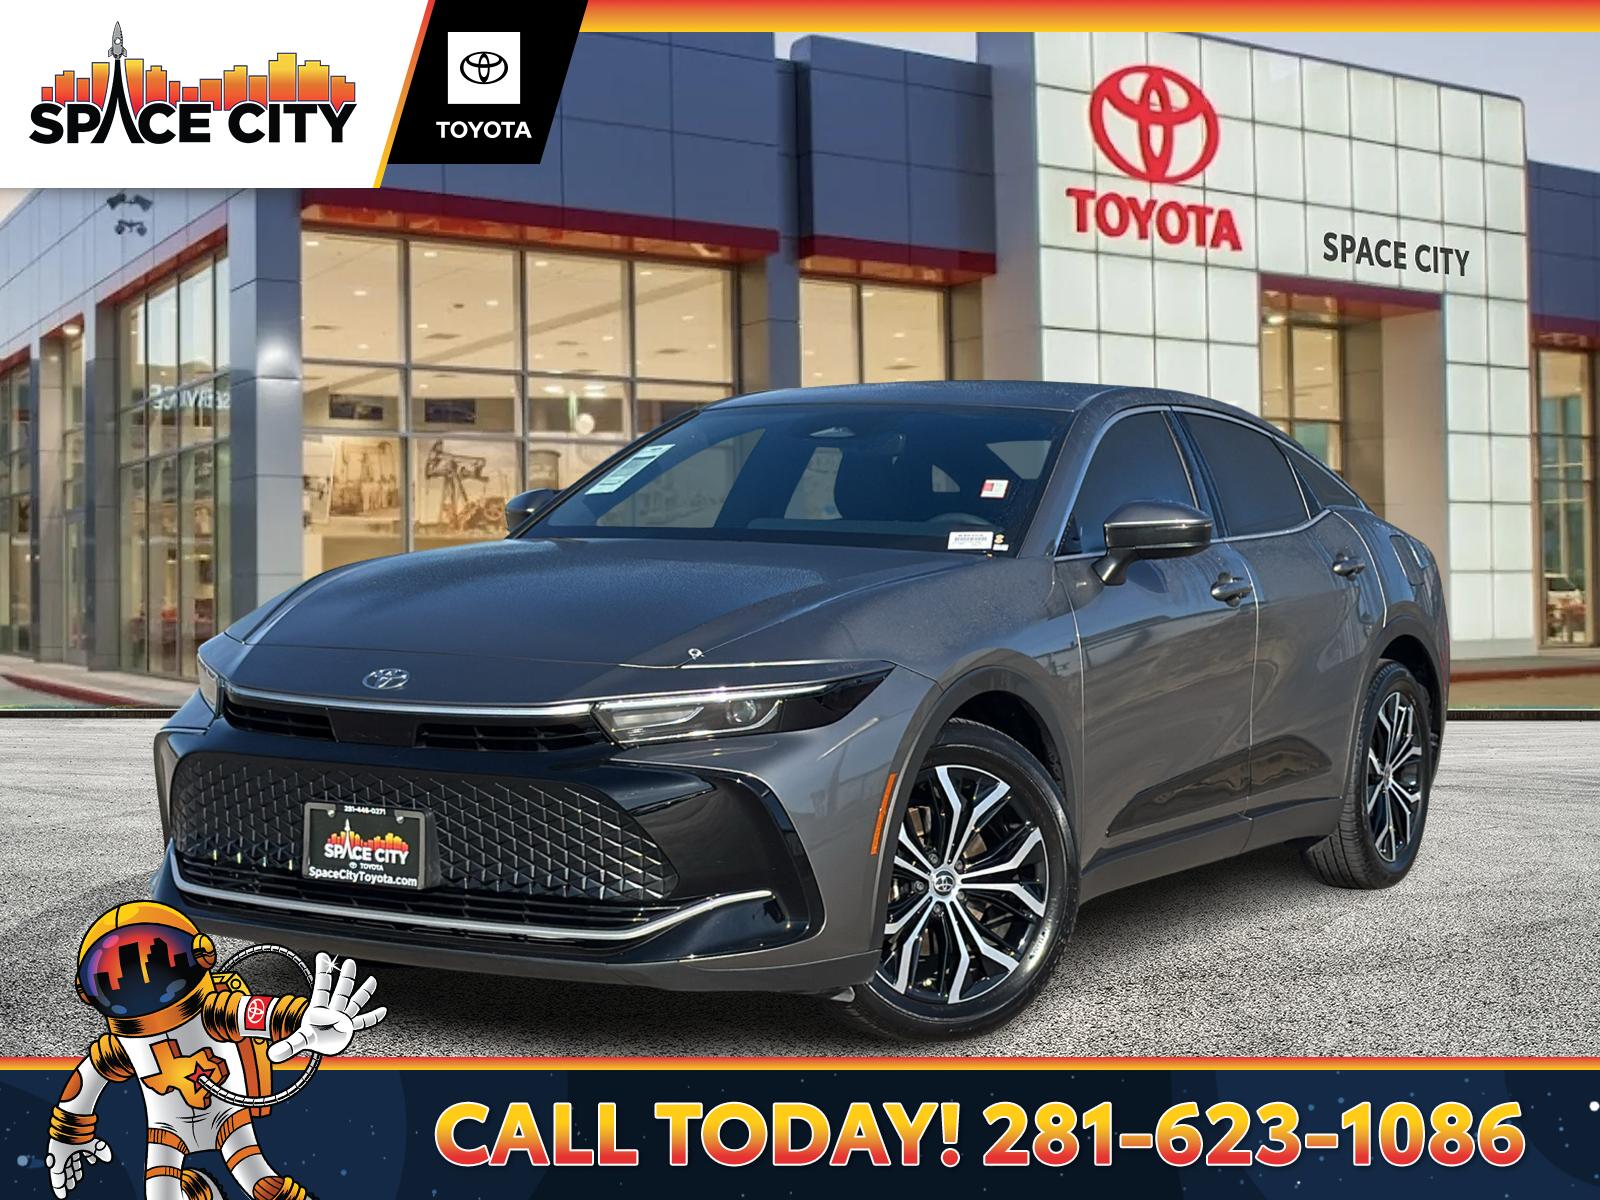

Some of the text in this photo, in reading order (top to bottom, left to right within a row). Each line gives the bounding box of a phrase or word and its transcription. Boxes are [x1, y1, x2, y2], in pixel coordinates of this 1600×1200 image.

[1066, 188, 1242, 251] TOYOTA
[1323, 232, 1470, 277] SPACE CITY
[324, 830, 409, 865] SPACE CITY
[309, 866, 418, 887] SpaceCityToyota.com
[360, 862, 384, 871] TOYOTA
